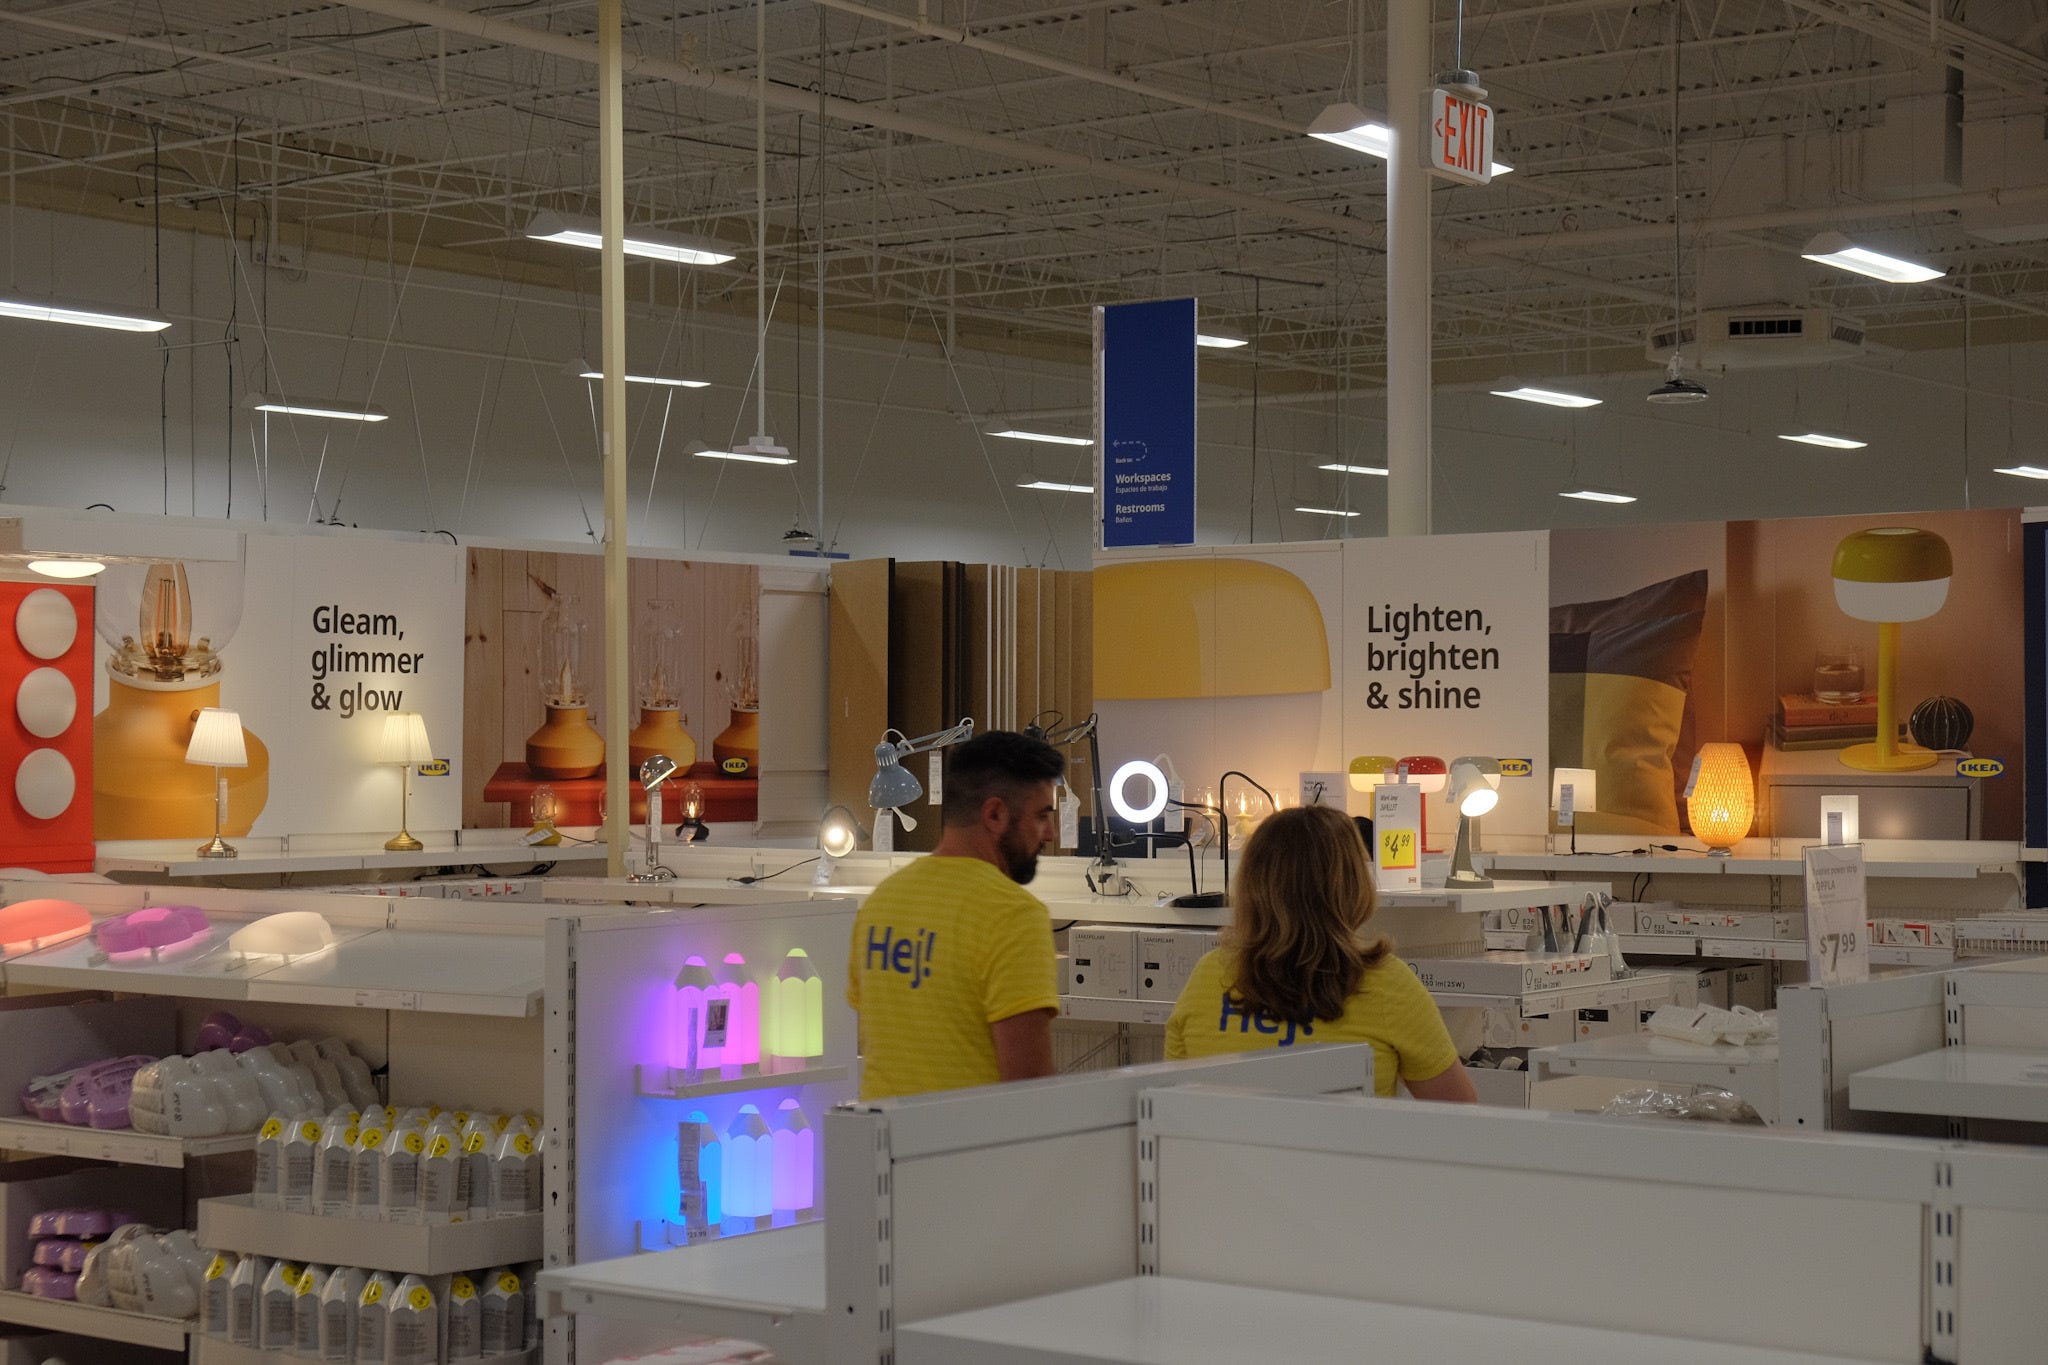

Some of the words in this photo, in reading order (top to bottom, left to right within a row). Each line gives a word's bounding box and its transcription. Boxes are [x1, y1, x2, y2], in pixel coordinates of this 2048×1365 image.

[1443, 96, 1487, 175] EXIT
[1115, 473, 1171, 484] Workspaces
[1115, 486, 1138, 494] Espacios
[1148, 484, 1168, 493] trabajo
[1115, 504, 1165, 513] Restrooms
[313, 605, 404, 640] Gleam,
[1368, 603, 1491, 641] Lighten,
[311, 643, 424, 680] glimmer
[1368, 641, 1499, 679] brighten
[311, 682, 331, 710] &
[340, 682, 403, 719] glow
[1366, 682, 1389, 709] &
[1398, 680, 1481, 709] shine
[421, 763, 447, 771] IKEA
[1961, 763, 2000, 772] IKEA
[867, 926, 935, 989] Hej!
